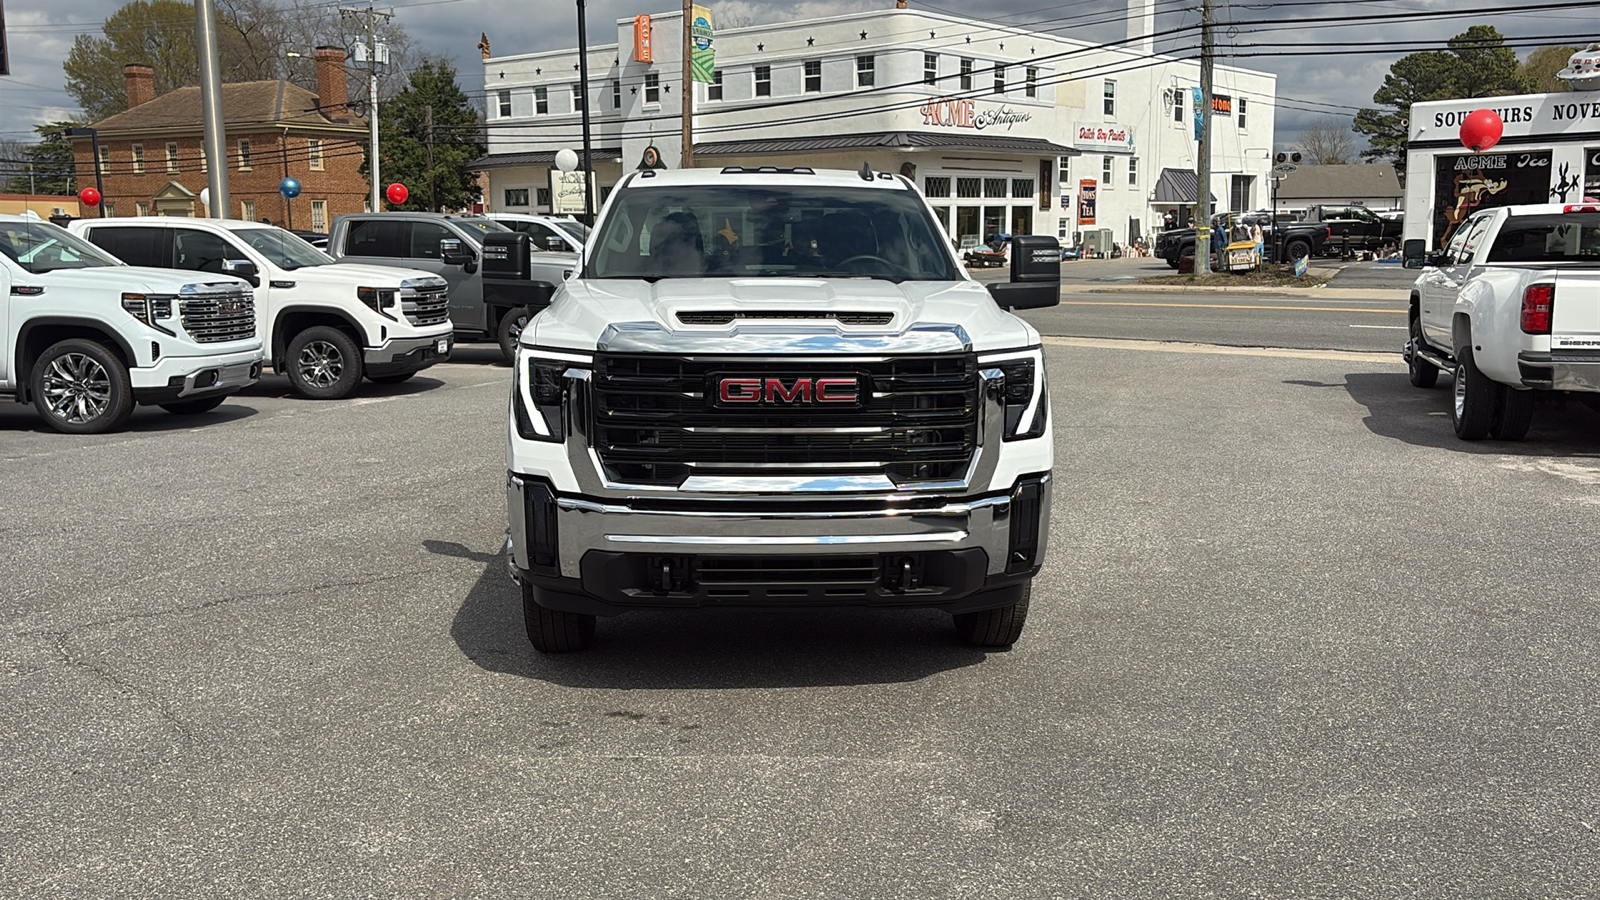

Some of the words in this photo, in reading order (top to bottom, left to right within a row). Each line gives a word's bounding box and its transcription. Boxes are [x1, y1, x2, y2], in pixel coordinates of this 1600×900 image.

[920, 97, 975, 128] ACME
[975, 103, 1032, 131] Antiques
[1434, 106, 1533, 128] SOUNIRS
[1079, 127, 1095, 140] Dutch
[1096, 128, 1107, 143] Boy
[1108, 129, 1126, 142] Paints
[1454, 155, 1507, 170] ACME
[1517, 153, 1549, 168] Ice
[1082, 205, 1094, 216] TEA
[720, 378, 858, 403] GMC
